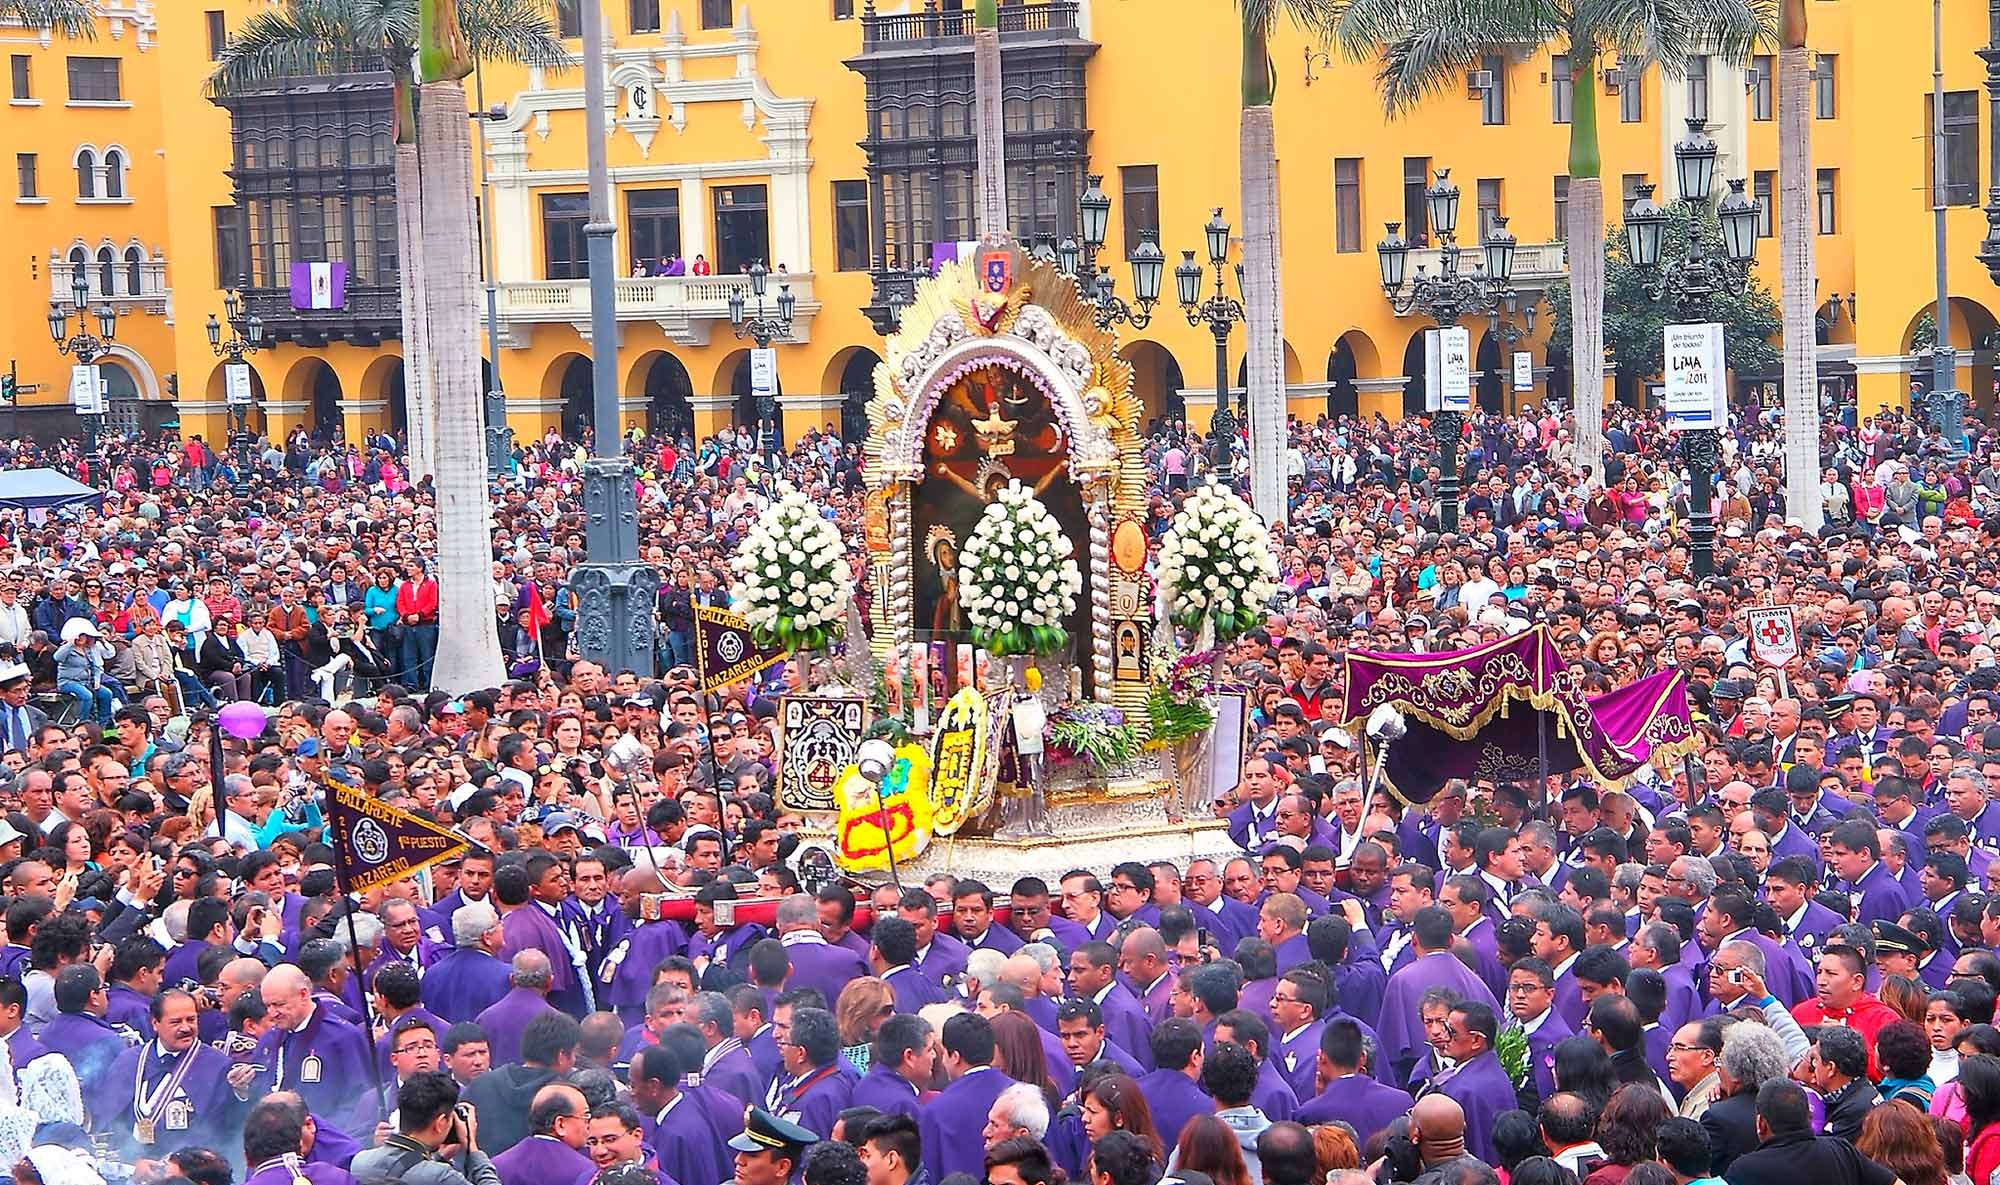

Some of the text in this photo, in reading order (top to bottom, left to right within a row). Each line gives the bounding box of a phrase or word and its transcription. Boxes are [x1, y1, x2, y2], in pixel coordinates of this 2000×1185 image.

[699, 609, 754, 633] GALLARDET
[1752, 609, 1788, 618] HSMN
[701, 629, 709, 669] 2011
[705, 654, 764, 688] NAZARENO
[335, 790, 404, 829] GALLARDETE
[338, 815, 352, 866] 2013
[410, 836, 447, 849] PUESTO
[349, 855, 410, 891] NAZARENO
